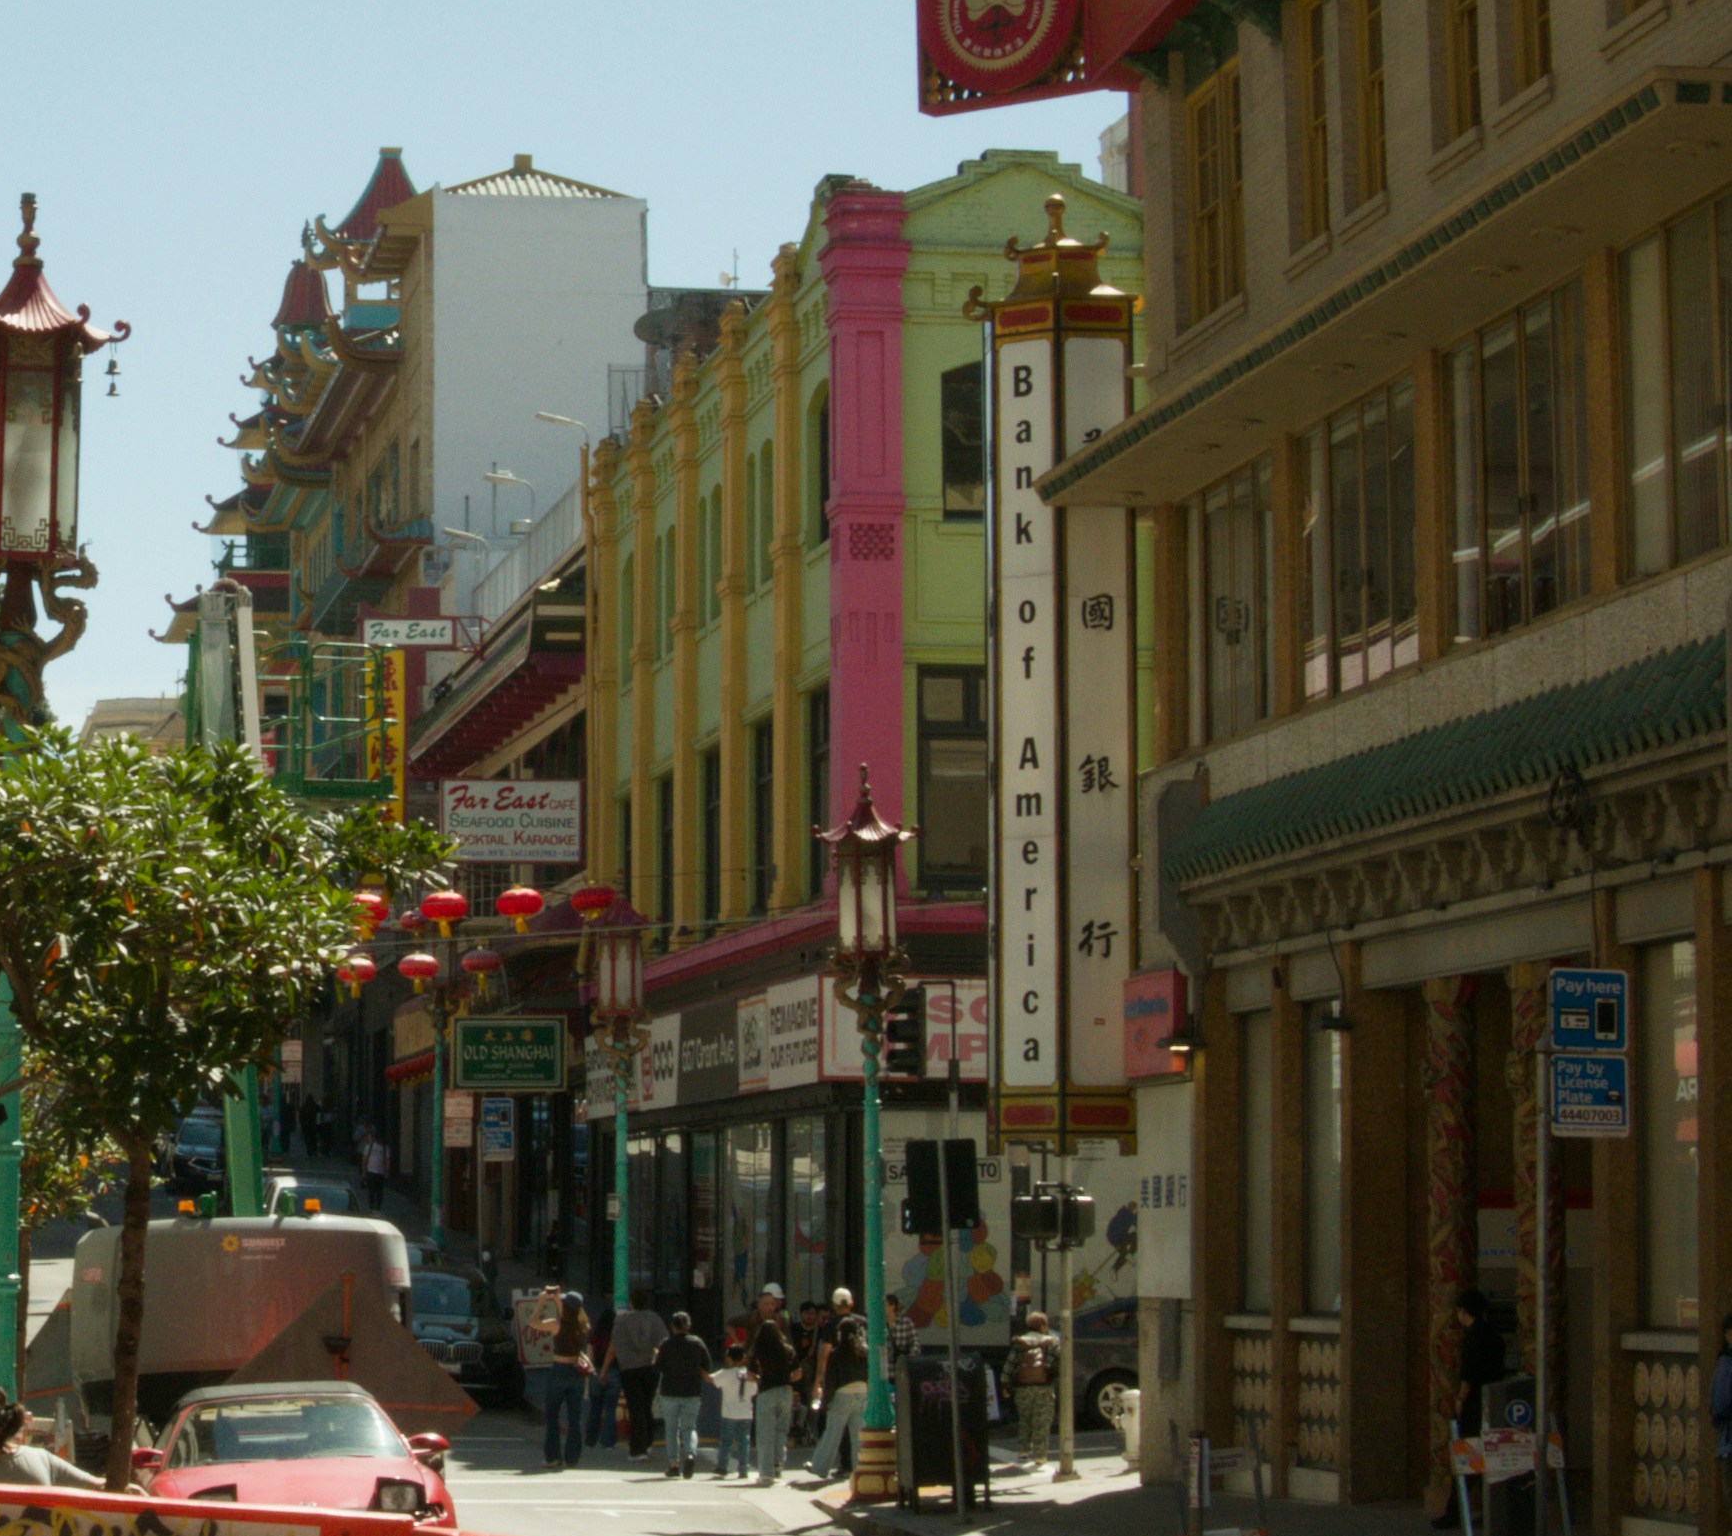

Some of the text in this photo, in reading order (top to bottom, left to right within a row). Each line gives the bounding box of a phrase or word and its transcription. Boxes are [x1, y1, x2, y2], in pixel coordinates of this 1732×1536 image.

[1010, 365, 1036, 546] Bank
[369, 624, 448, 639] Far East
[1018, 598, 1038, 680] of
[448, 785, 489, 811] Far
[494, 786, 550, 811] East
[513, 830, 575, 846] KARAOKE
[1015, 737, 1043, 1064] America
[1556, 977, 1622, 996] Pay here
[463, 1045, 555, 1060] OLD SHANGHAI
[1557, 1061, 1604, 1076] Pay by
[1557, 1077, 1609, 1090] License
[1558, 1090, 1594, 1104] Plate
